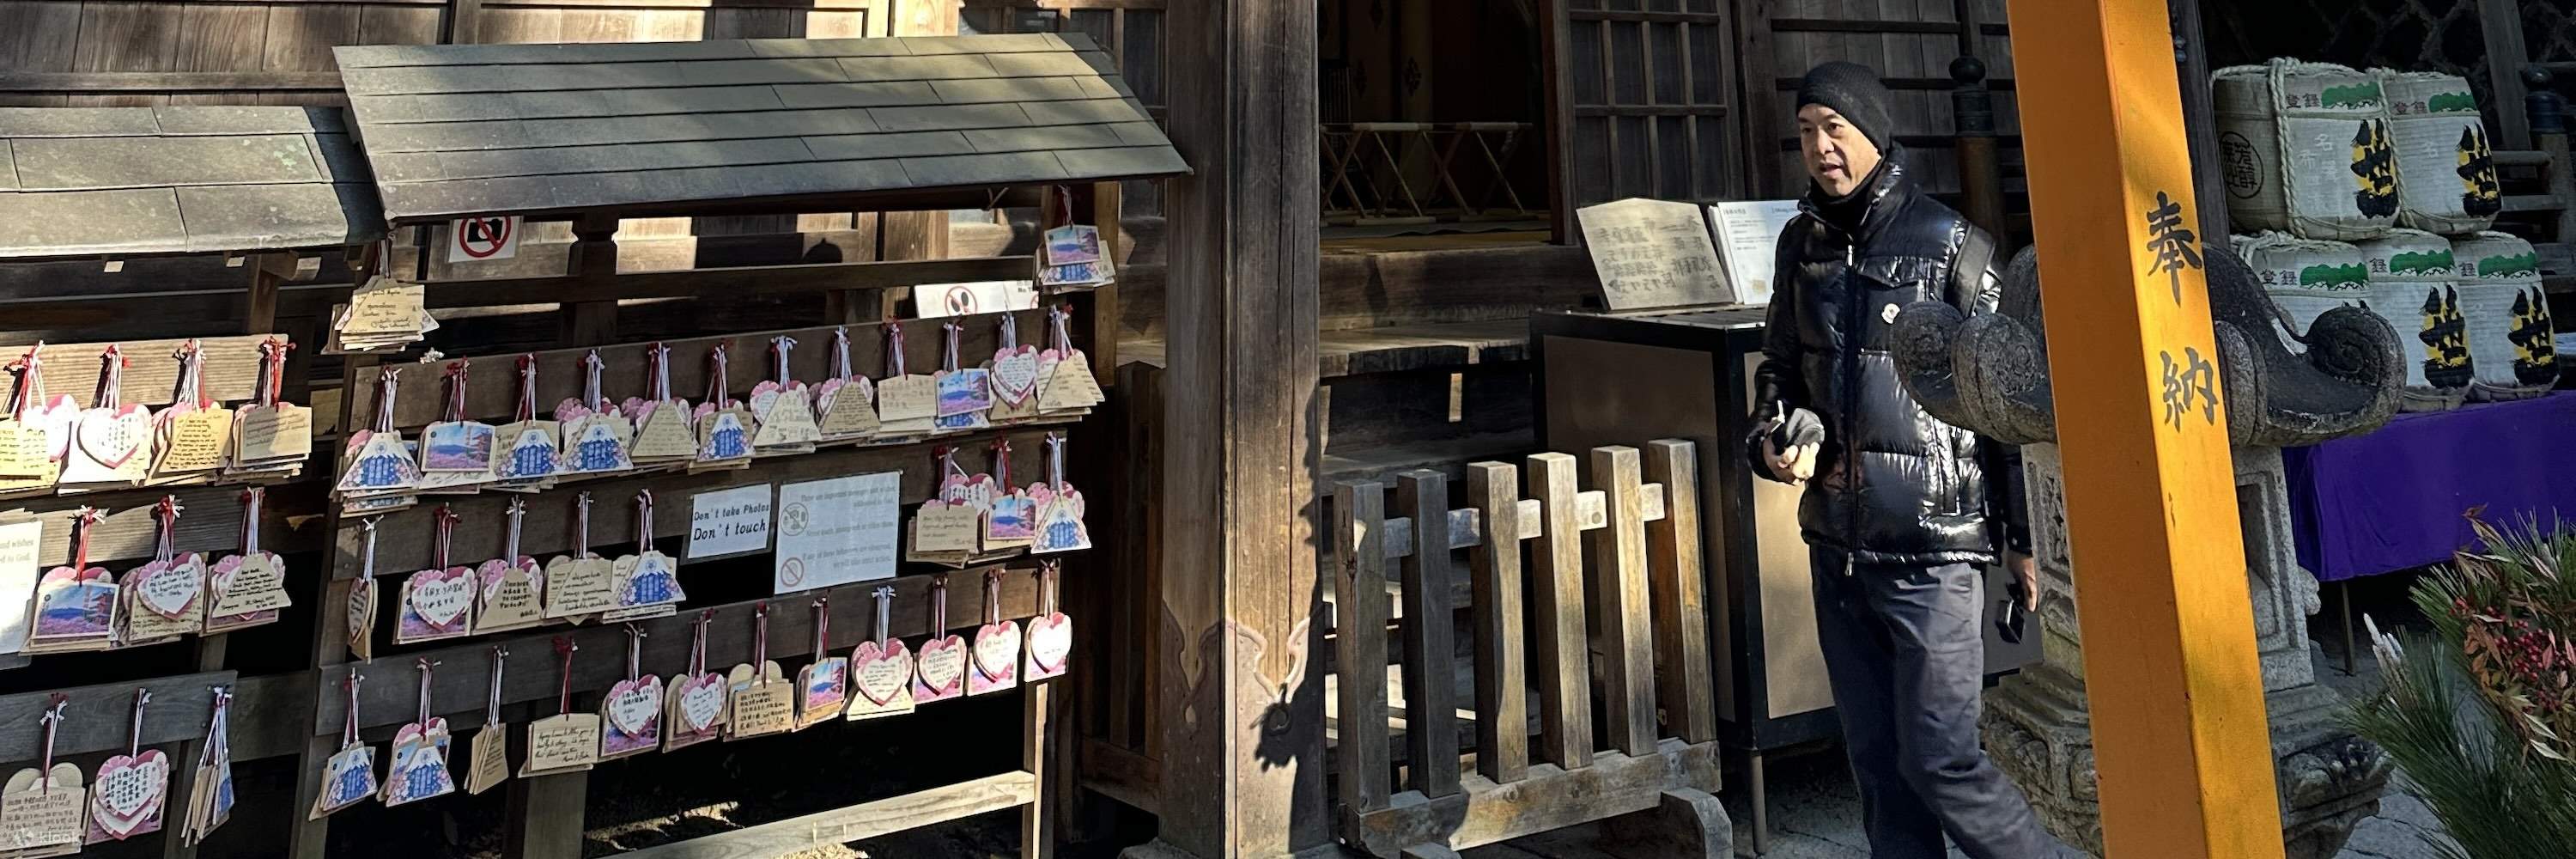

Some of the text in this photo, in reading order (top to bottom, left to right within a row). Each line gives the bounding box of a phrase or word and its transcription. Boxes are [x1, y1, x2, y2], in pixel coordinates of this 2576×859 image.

[2146, 190, 2219, 434] 奉納
[694, 503, 769, 521] Don't take Photos
[693, 517, 766, 541] Don't touch
